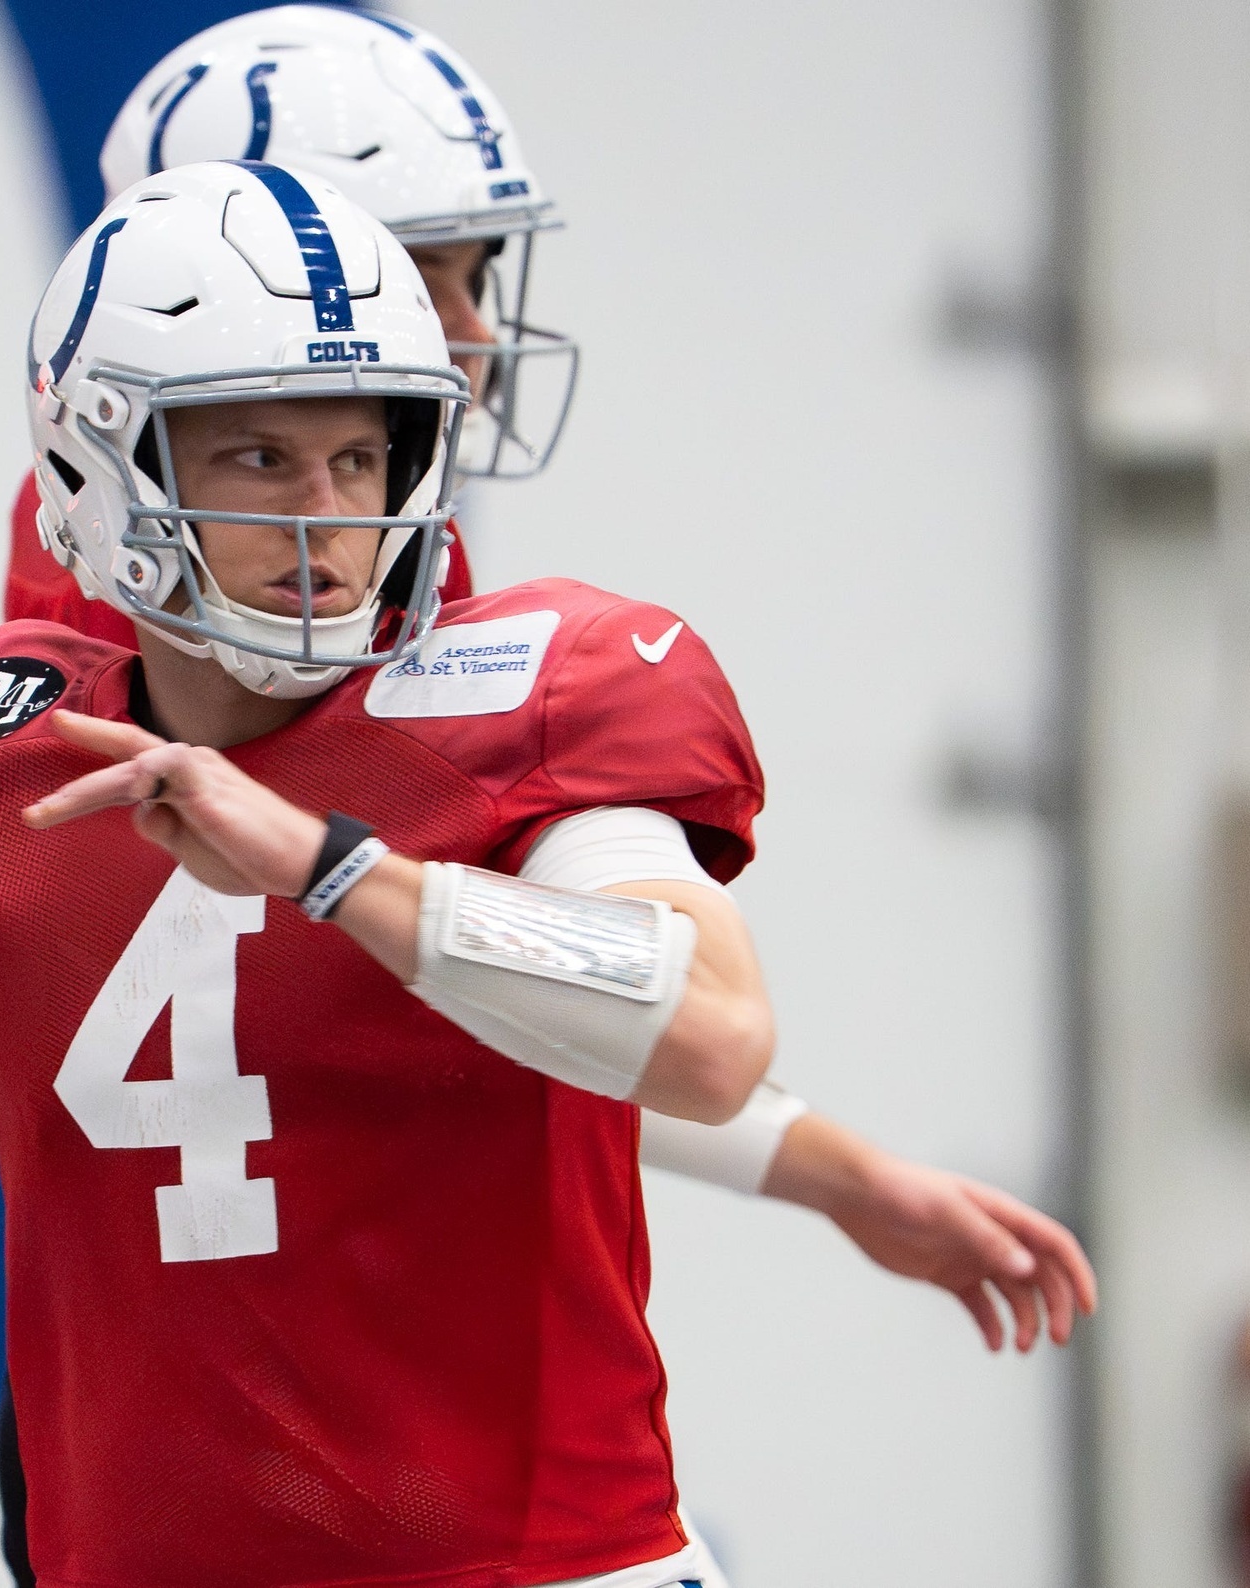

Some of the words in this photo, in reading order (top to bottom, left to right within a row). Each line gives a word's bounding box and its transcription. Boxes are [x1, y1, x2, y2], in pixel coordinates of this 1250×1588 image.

[307, 341, 380, 363] COLTS
[437, 641, 530, 658] Ascension
[460, 660, 528, 674] Vincent
[53, 862, 279, 1263] 4
